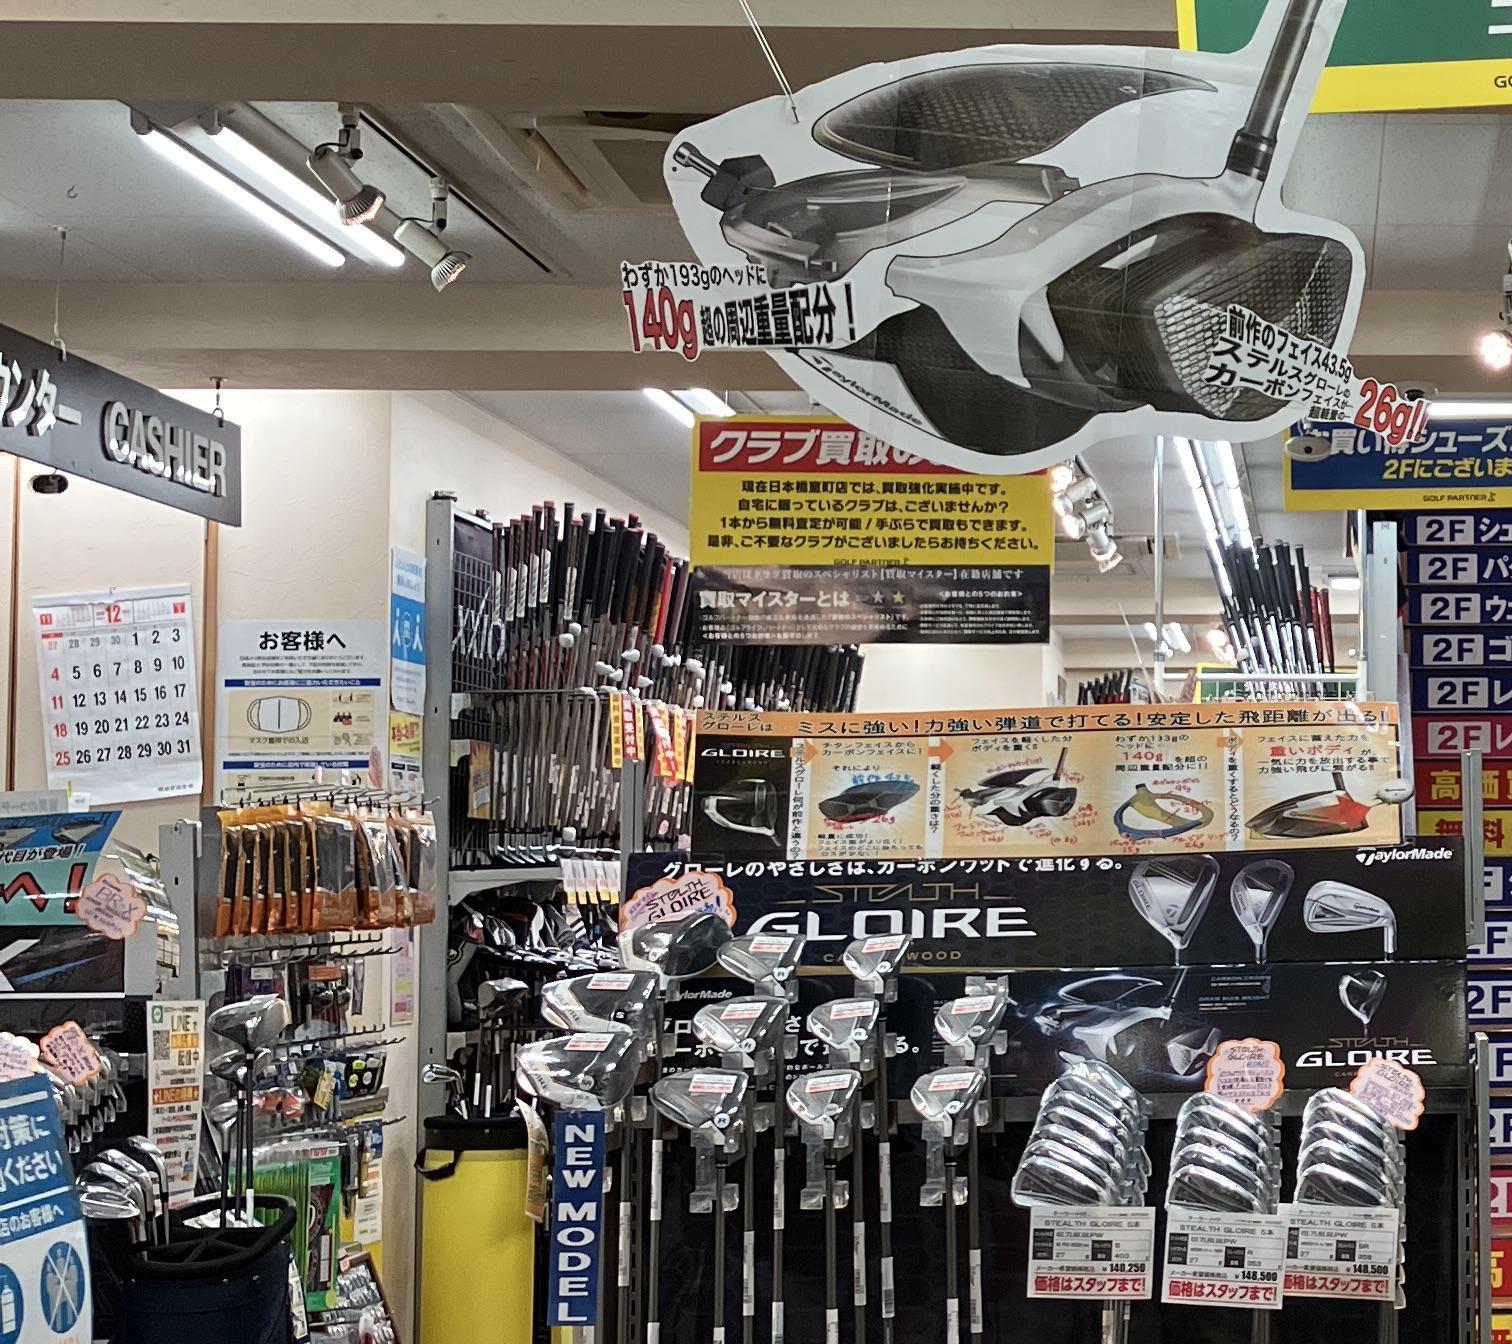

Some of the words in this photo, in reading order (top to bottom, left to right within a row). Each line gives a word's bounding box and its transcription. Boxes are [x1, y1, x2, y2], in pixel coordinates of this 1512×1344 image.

[623, 263, 766, 290] わずか193gのヘッドに
[623, 285, 698, 359] 140g
[103, 401, 227, 497] CASHIER
[1426, 519, 1466, 542] 2F
[1428, 557, 1469, 581] 2F
[105, 604, 122, 623] 12
[1430, 597, 1471, 620] 2F
[133, 632, 138, 645] 1
[152, 630, 160, 644] 2
[173, 628, 180, 642] 3
[259, 631, 346, 651] お客様へ
[1432, 638, 1475, 662] 2F
[51, 668, 59, 681] 4
[73, 666, 81, 679] 5
[93, 664, 101, 677] 6
[113, 662, 121, 675] 7
[134, 660, 142, 674] 8
[154, 658, 162, 671] 9
[173, 656, 185, 669] 10
[52, 696, 63, 709] 11
[73, 694, 86, 707] 12
[94, 692, 106, 706] 13
[114, 690, 127, 704] 14
[134, 688, 147, 702] 15
[155, 686, 167, 700] 16
[174, 684, 186, 697] 17
[1436, 681, 1480, 705] 2F
[54, 724, 67, 737] 18
[75, 722, 88, 735] 19
[95, 720, 109, 734] 20
[115, 718, 128, 732] 21
[135, 716, 149, 730] 22
[155, 714, 169, 728] 23
[175, 712, 189, 725] 24
[1437, 726, 1482, 750] 2F
[56, 752, 70, 766] 25
[76, 750, 91, 764] 26
[97, 748, 111, 762] 27
[117, 746, 131, 760] 28
[137, 744, 152, 758] 29
[157, 741, 171, 755] 30
[177, 739, 191, 754] 31
[701, 748, 785, 758] GLOIRE
[1355, 847, 1452, 866] TaylorMade
[745, 906, 1037, 941] GLOIRE
[1296, 1049, 1438, 1067] GLOIRE
[563, 1123, 594, 1189] NEW
[557, 1201, 597, 1322] MODEL
